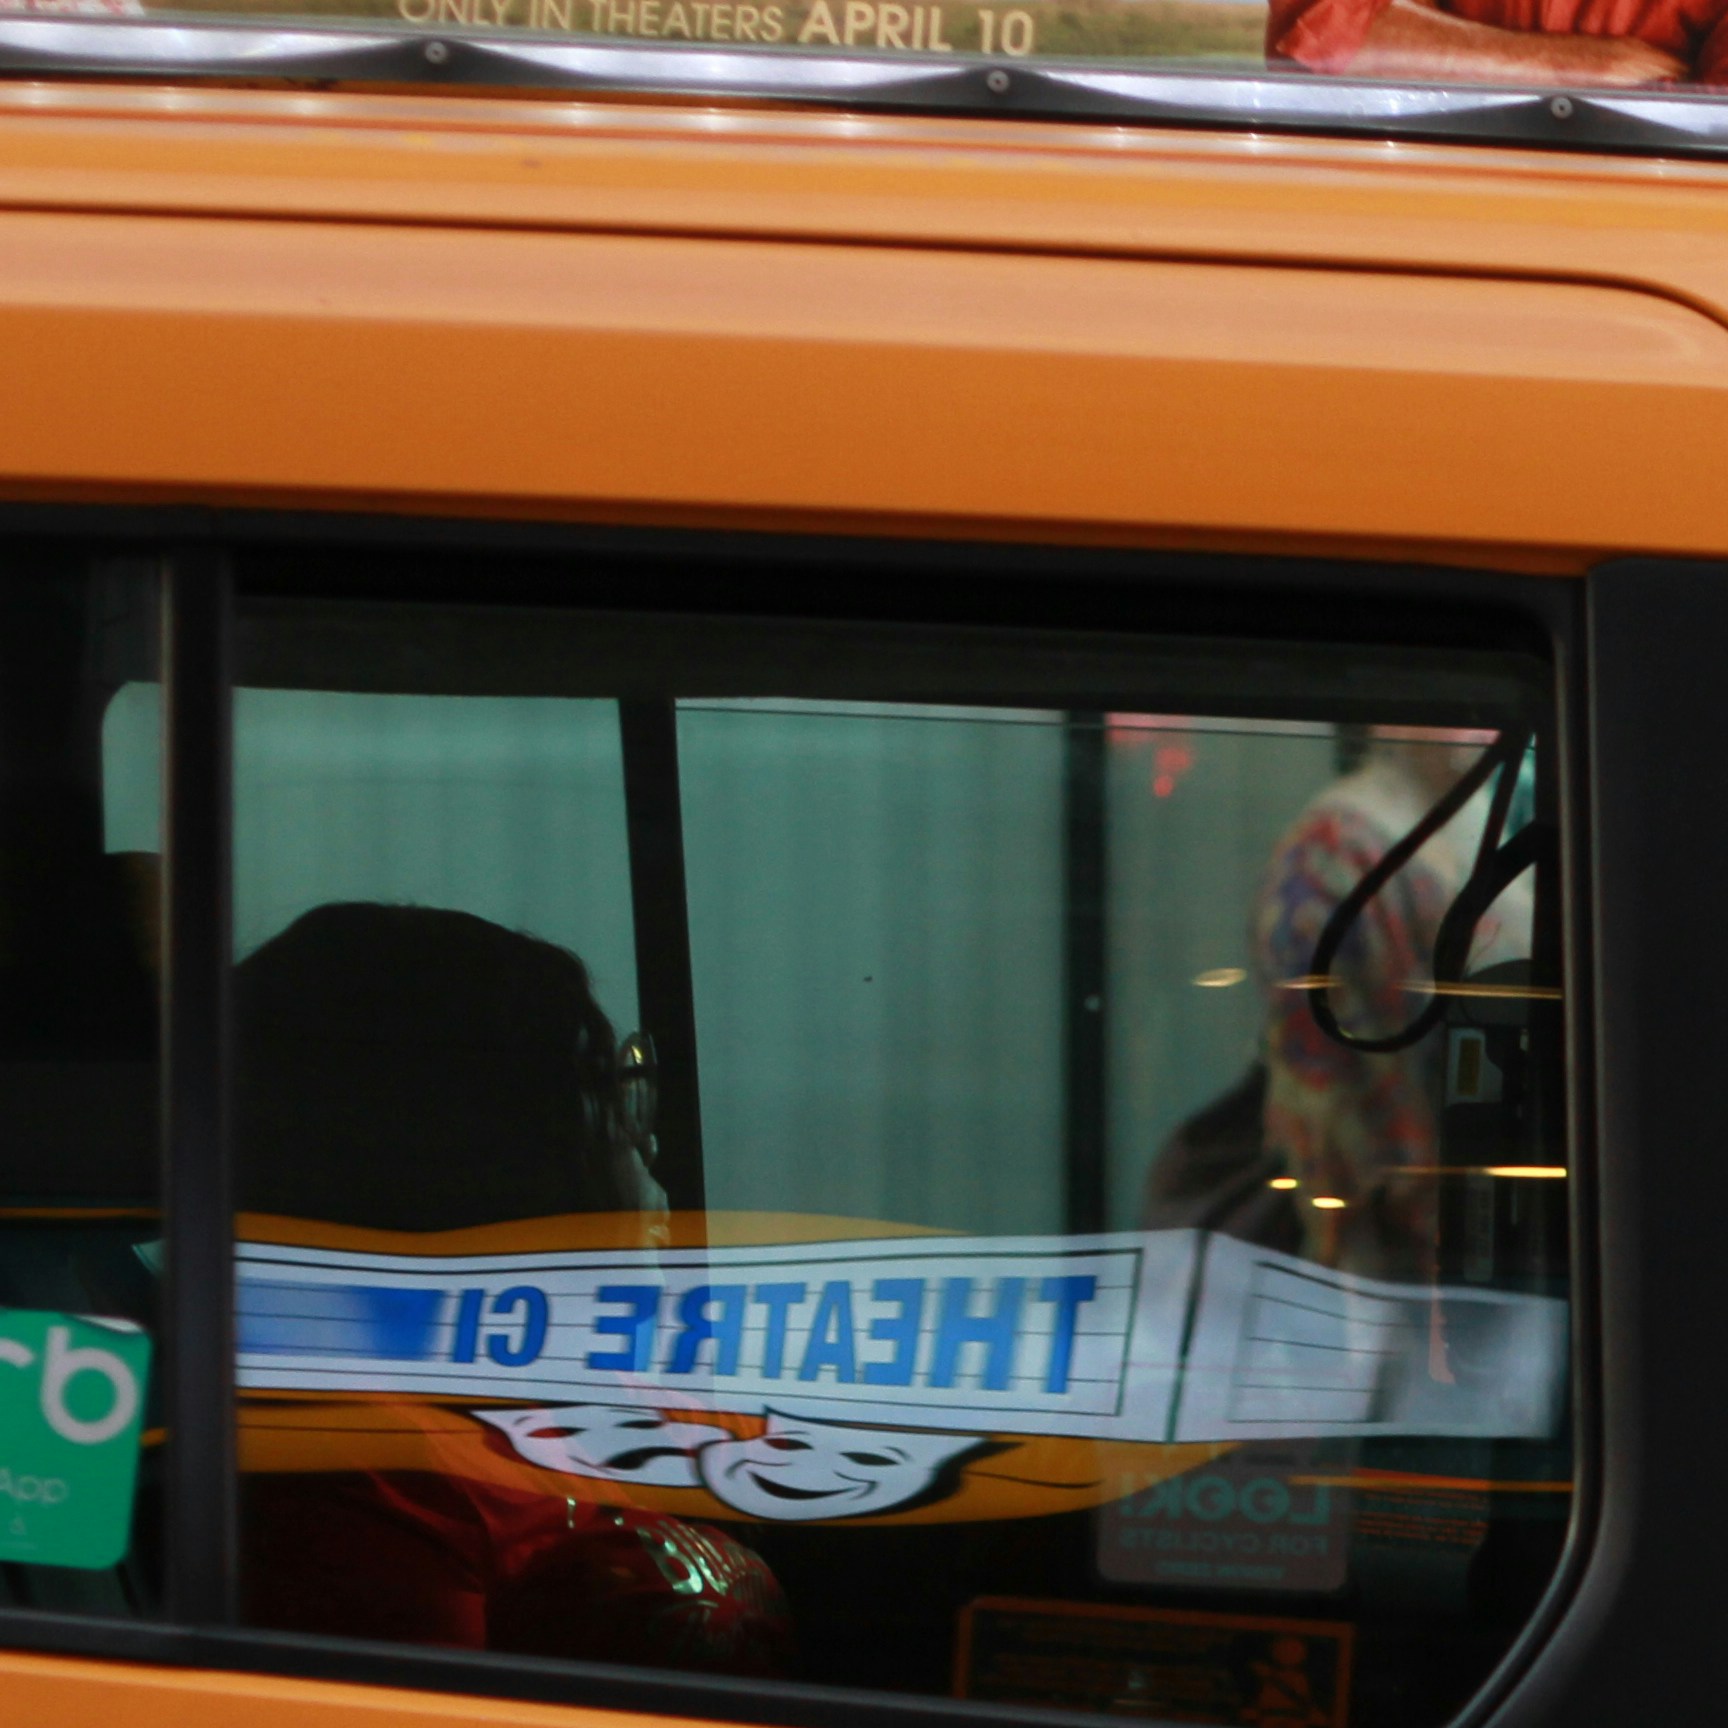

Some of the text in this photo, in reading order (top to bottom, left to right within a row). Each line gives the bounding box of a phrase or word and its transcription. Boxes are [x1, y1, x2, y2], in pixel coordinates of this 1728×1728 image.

[398, 0, 1035, 56] ONLY IN THEATERS APRIL 10
